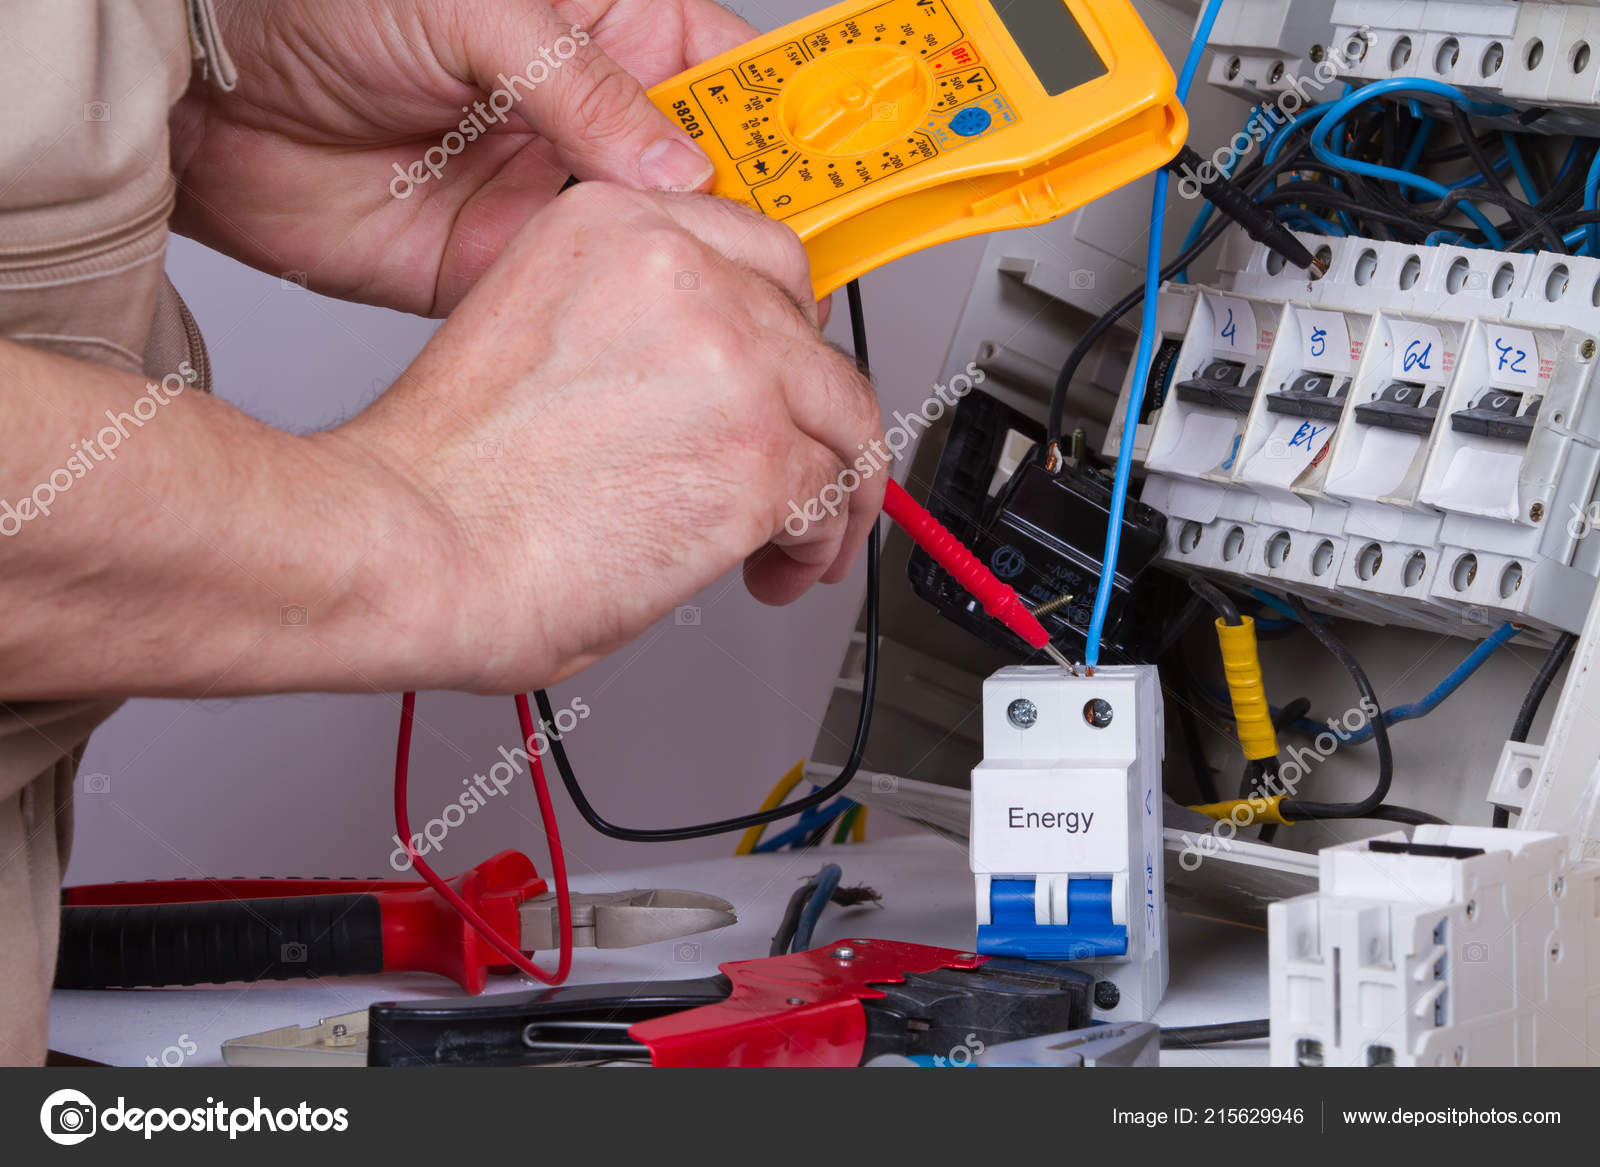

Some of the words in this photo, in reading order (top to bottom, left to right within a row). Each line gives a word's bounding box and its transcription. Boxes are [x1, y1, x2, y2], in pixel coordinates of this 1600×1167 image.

[845, 21, 861, 38] 2000
[874, 23, 886, 33] 20
[900, 23, 915, 37] 200
[816, 33, 830, 46] 200
[923, 33, 938, 47] 500
[784, 46, 800, 62] 1.5V
[951, 47, 971, 64] OFF
[748, 64, 764, 82] BATT
[764, 67, 777, 78] 9V
[950, 76, 964, 90] 500
[749, 96, 764, 111] 200
[944, 92, 958, 106] 200
[672, 100, 704, 139] 58203
[748, 117, 761, 128] 20
[750, 130, 767, 148] 2000
[915, 139, 933, 158] 2000
[889, 154, 904, 169] 200
[798, 168, 813, 182] 200
[828, 171, 844, 189] 2000
[1220, 308, 1236, 347] 4
[1008, 807, 1094, 833] Energy
